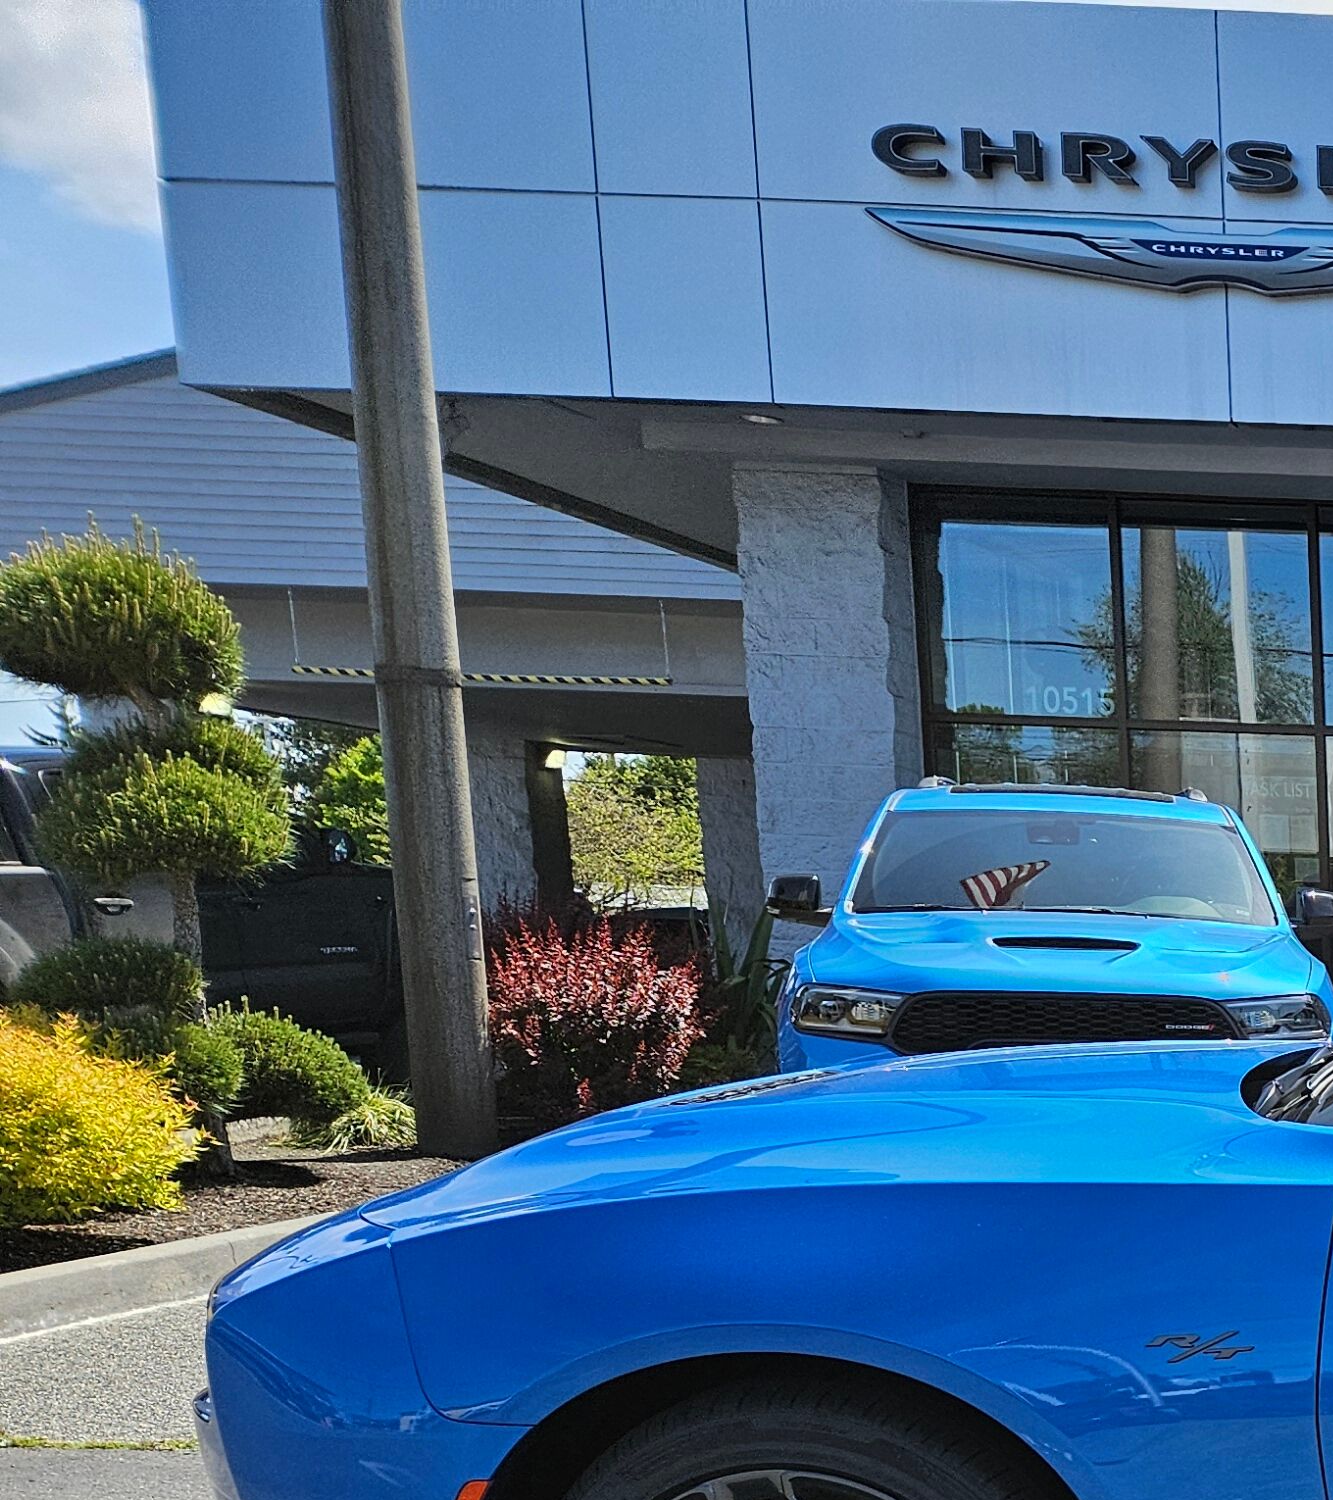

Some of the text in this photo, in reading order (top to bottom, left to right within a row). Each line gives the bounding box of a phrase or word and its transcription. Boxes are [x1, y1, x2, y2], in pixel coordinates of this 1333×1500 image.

[1151, 243, 1285, 258] CHRYSLER
[1024, 685, 1117, 716] 10515
[1283, 781, 1311, 799] LIST
[1144, 1329, 1256, 1364] R/T
